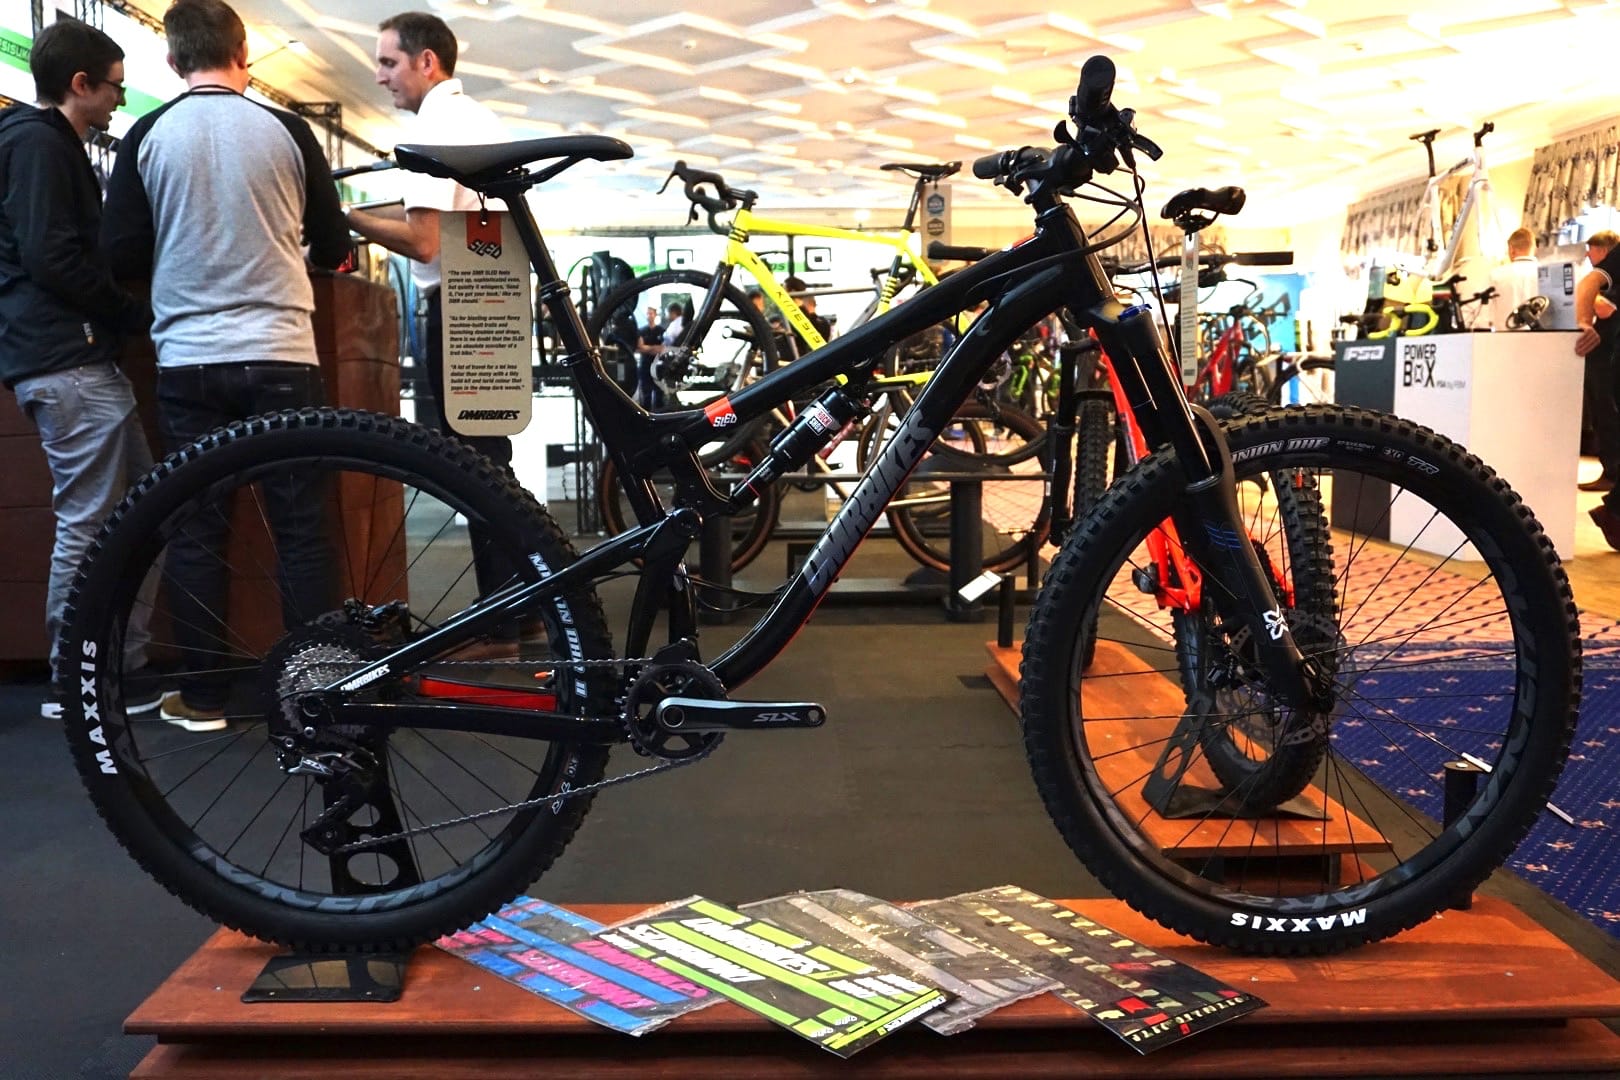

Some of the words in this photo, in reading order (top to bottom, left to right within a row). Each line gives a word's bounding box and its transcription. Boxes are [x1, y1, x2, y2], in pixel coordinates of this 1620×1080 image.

[1403, 343, 1437, 360] POWER
[457, 409, 520, 420] DMRBIKES
[713, 412, 738, 427] SLED
[802, 408, 934, 597] DMRBIKES
[340, 664, 390, 692] DMRBIKES
[81, 639, 119, 775] MAXXIS
[753, 712, 801, 722] SLX
[1230, 908, 1367, 932] MAXXIS
